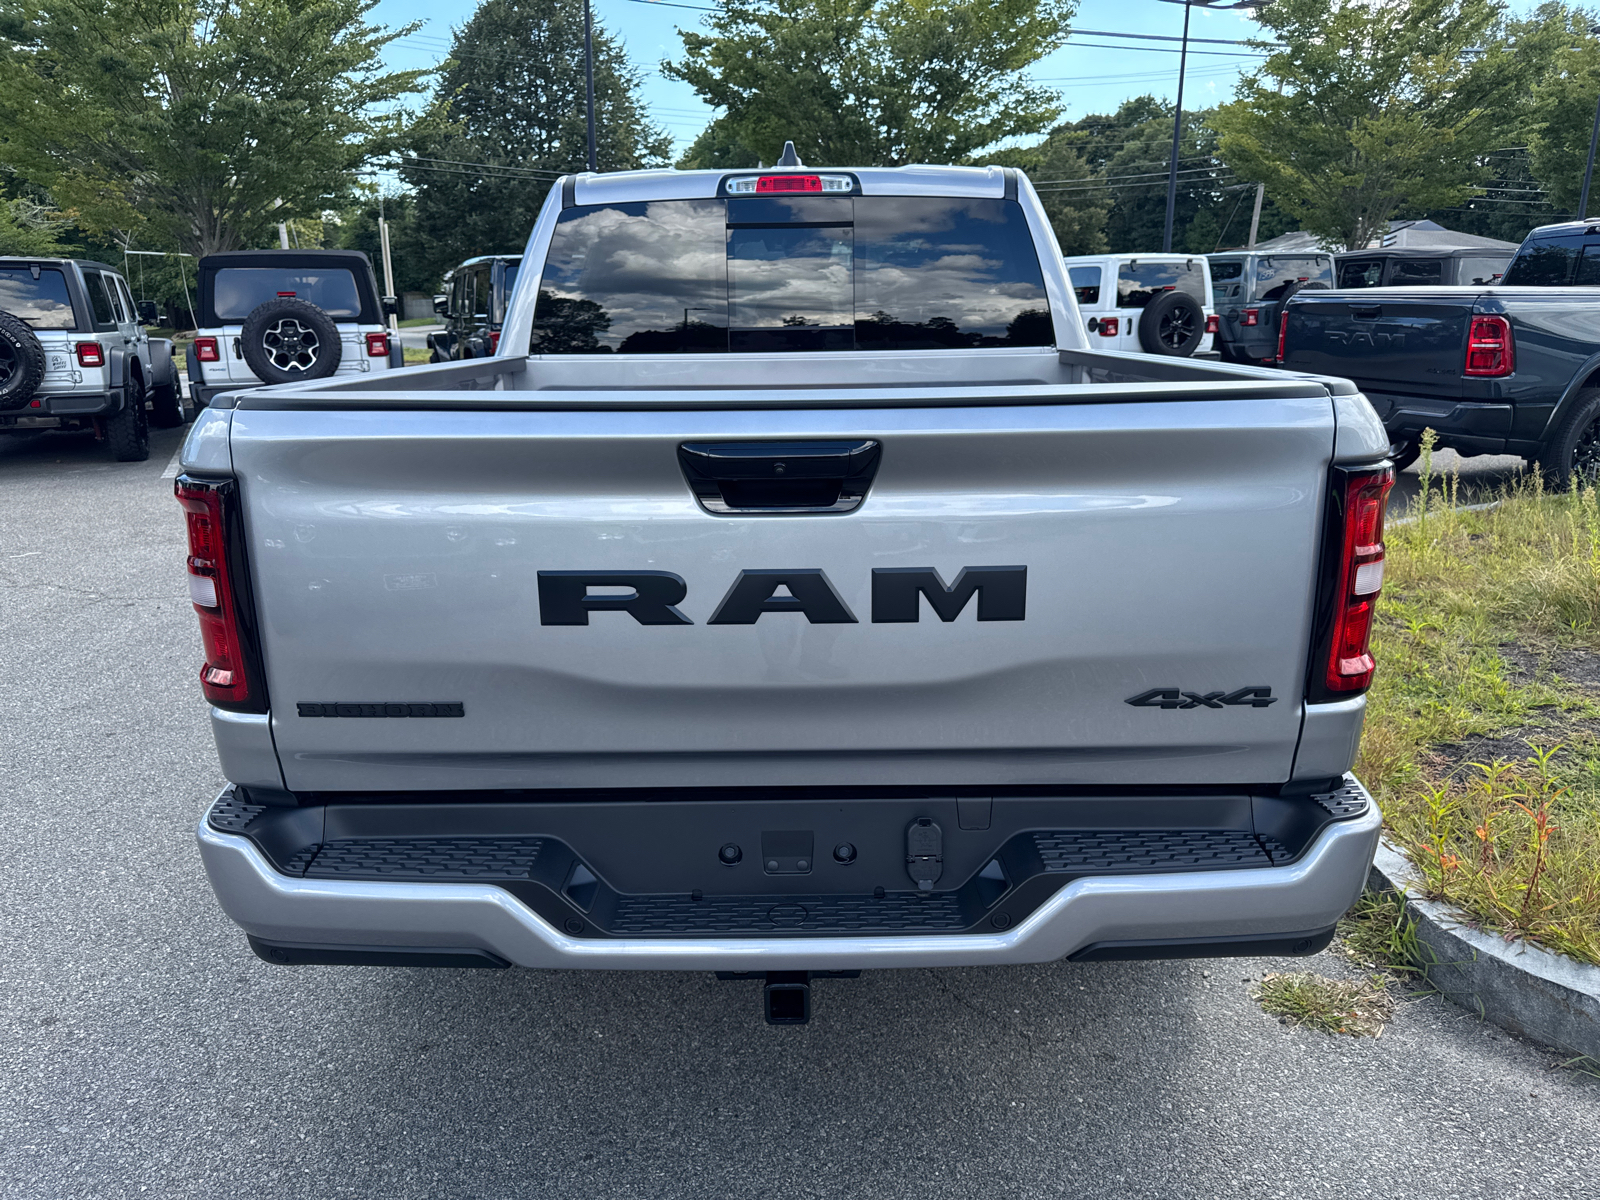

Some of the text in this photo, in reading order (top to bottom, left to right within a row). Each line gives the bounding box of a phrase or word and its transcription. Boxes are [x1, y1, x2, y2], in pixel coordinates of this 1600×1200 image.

[1324, 330, 1406, 348] RAM
[537, 565, 1028, 626] RAM
[1124, 685, 1278, 709] 4x4
